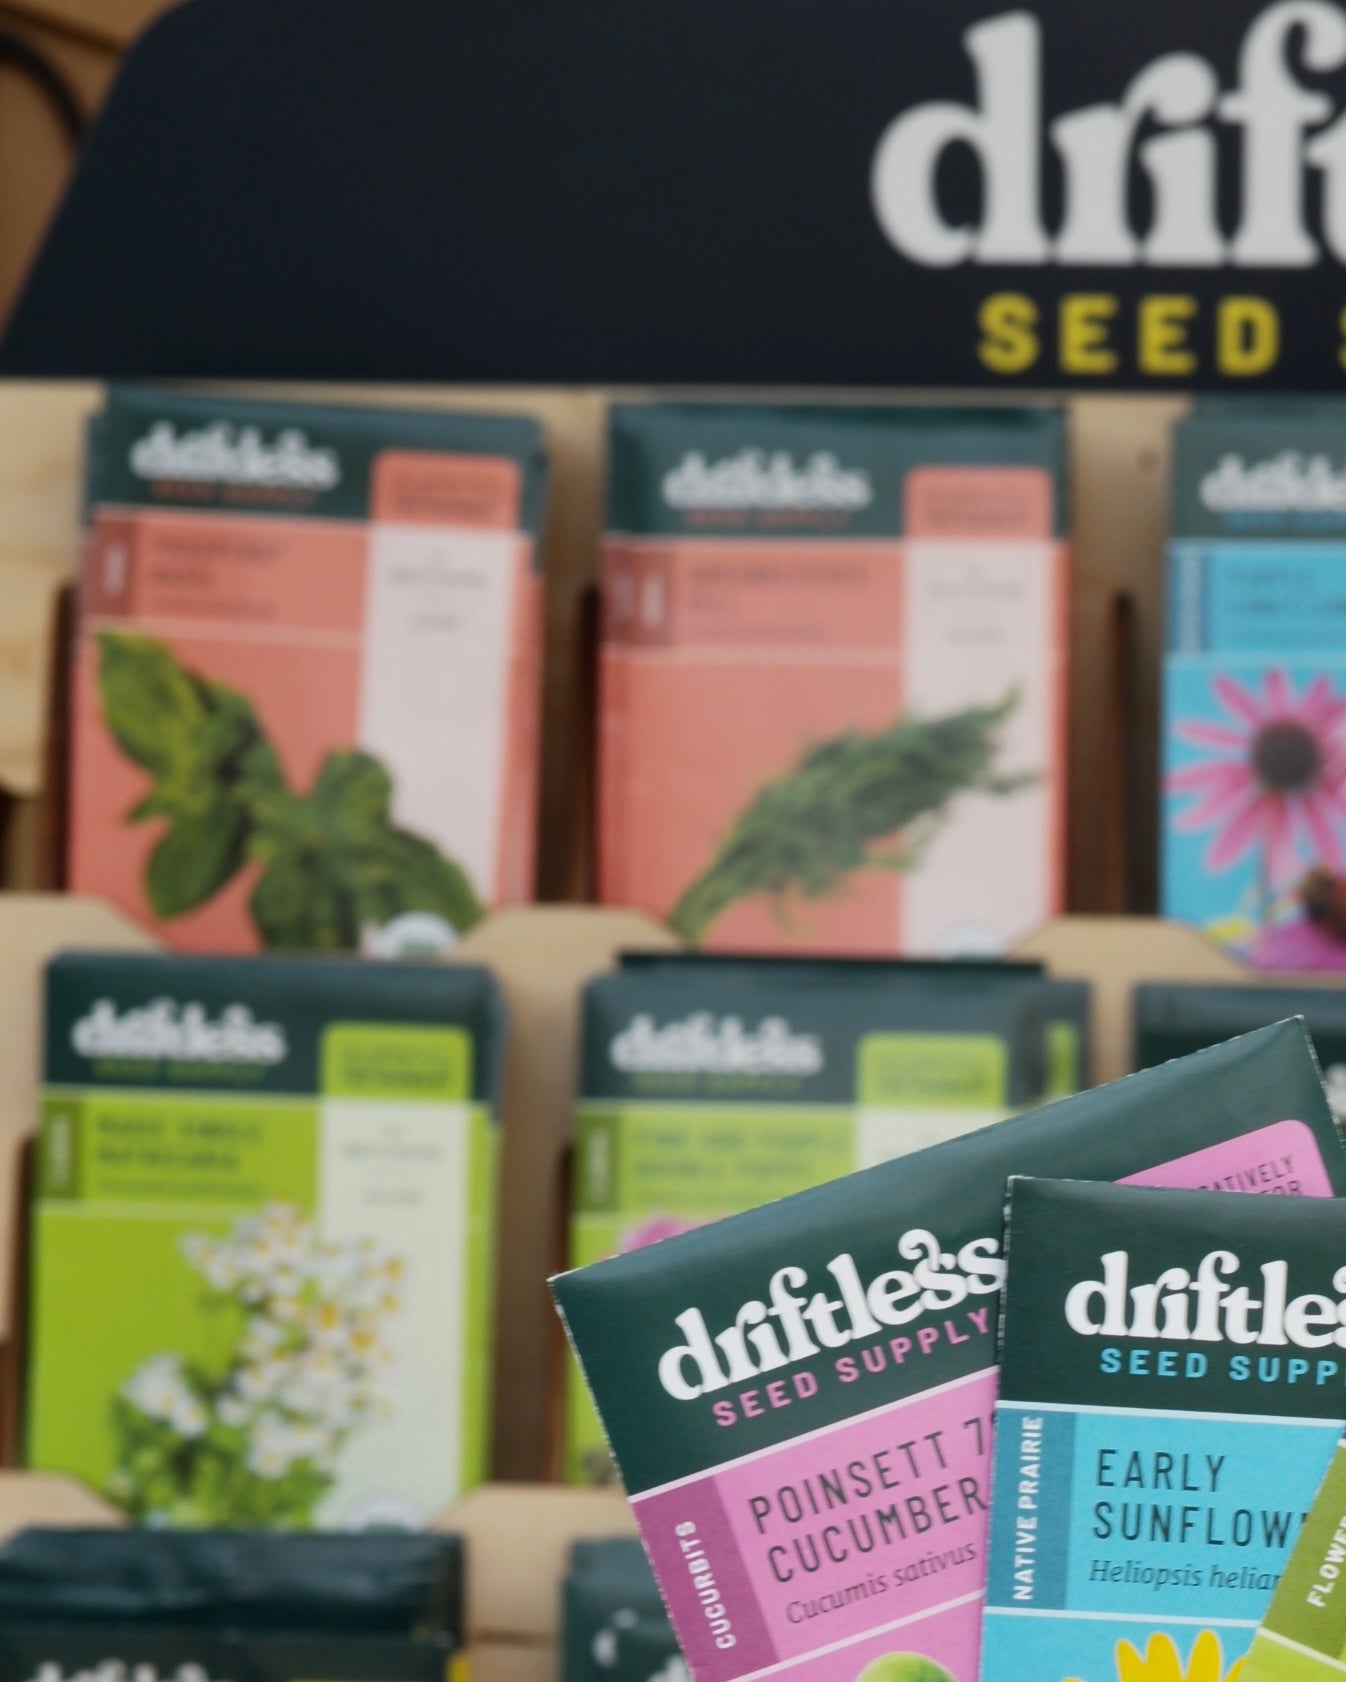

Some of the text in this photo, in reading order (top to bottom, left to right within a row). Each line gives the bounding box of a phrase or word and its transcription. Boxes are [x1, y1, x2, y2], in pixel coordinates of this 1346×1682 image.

[977, 292, 1281, 380] SEED
[658, 1228, 1007, 1400] driftless
[712, 1307, 989, 1428] SEED SUPPLY
[1099, 1347, 1208, 1379] SEED
[749, 1430, 947, 1535] POINSETT
[1012, 1416, 1044, 1601] NATIVE PRAIRIE
[1096, 1448, 1226, 1493] EARLY
[767, 1476, 989, 1584] CUCUMBER
[1092, 1500, 1310, 1549] SUNFLOW
[674, 1520, 738, 1650] CUCURBITS
[786, 1542, 978, 1624] Cucumis sativus
[1088, 1559, 1202, 1592] Heliopsis
